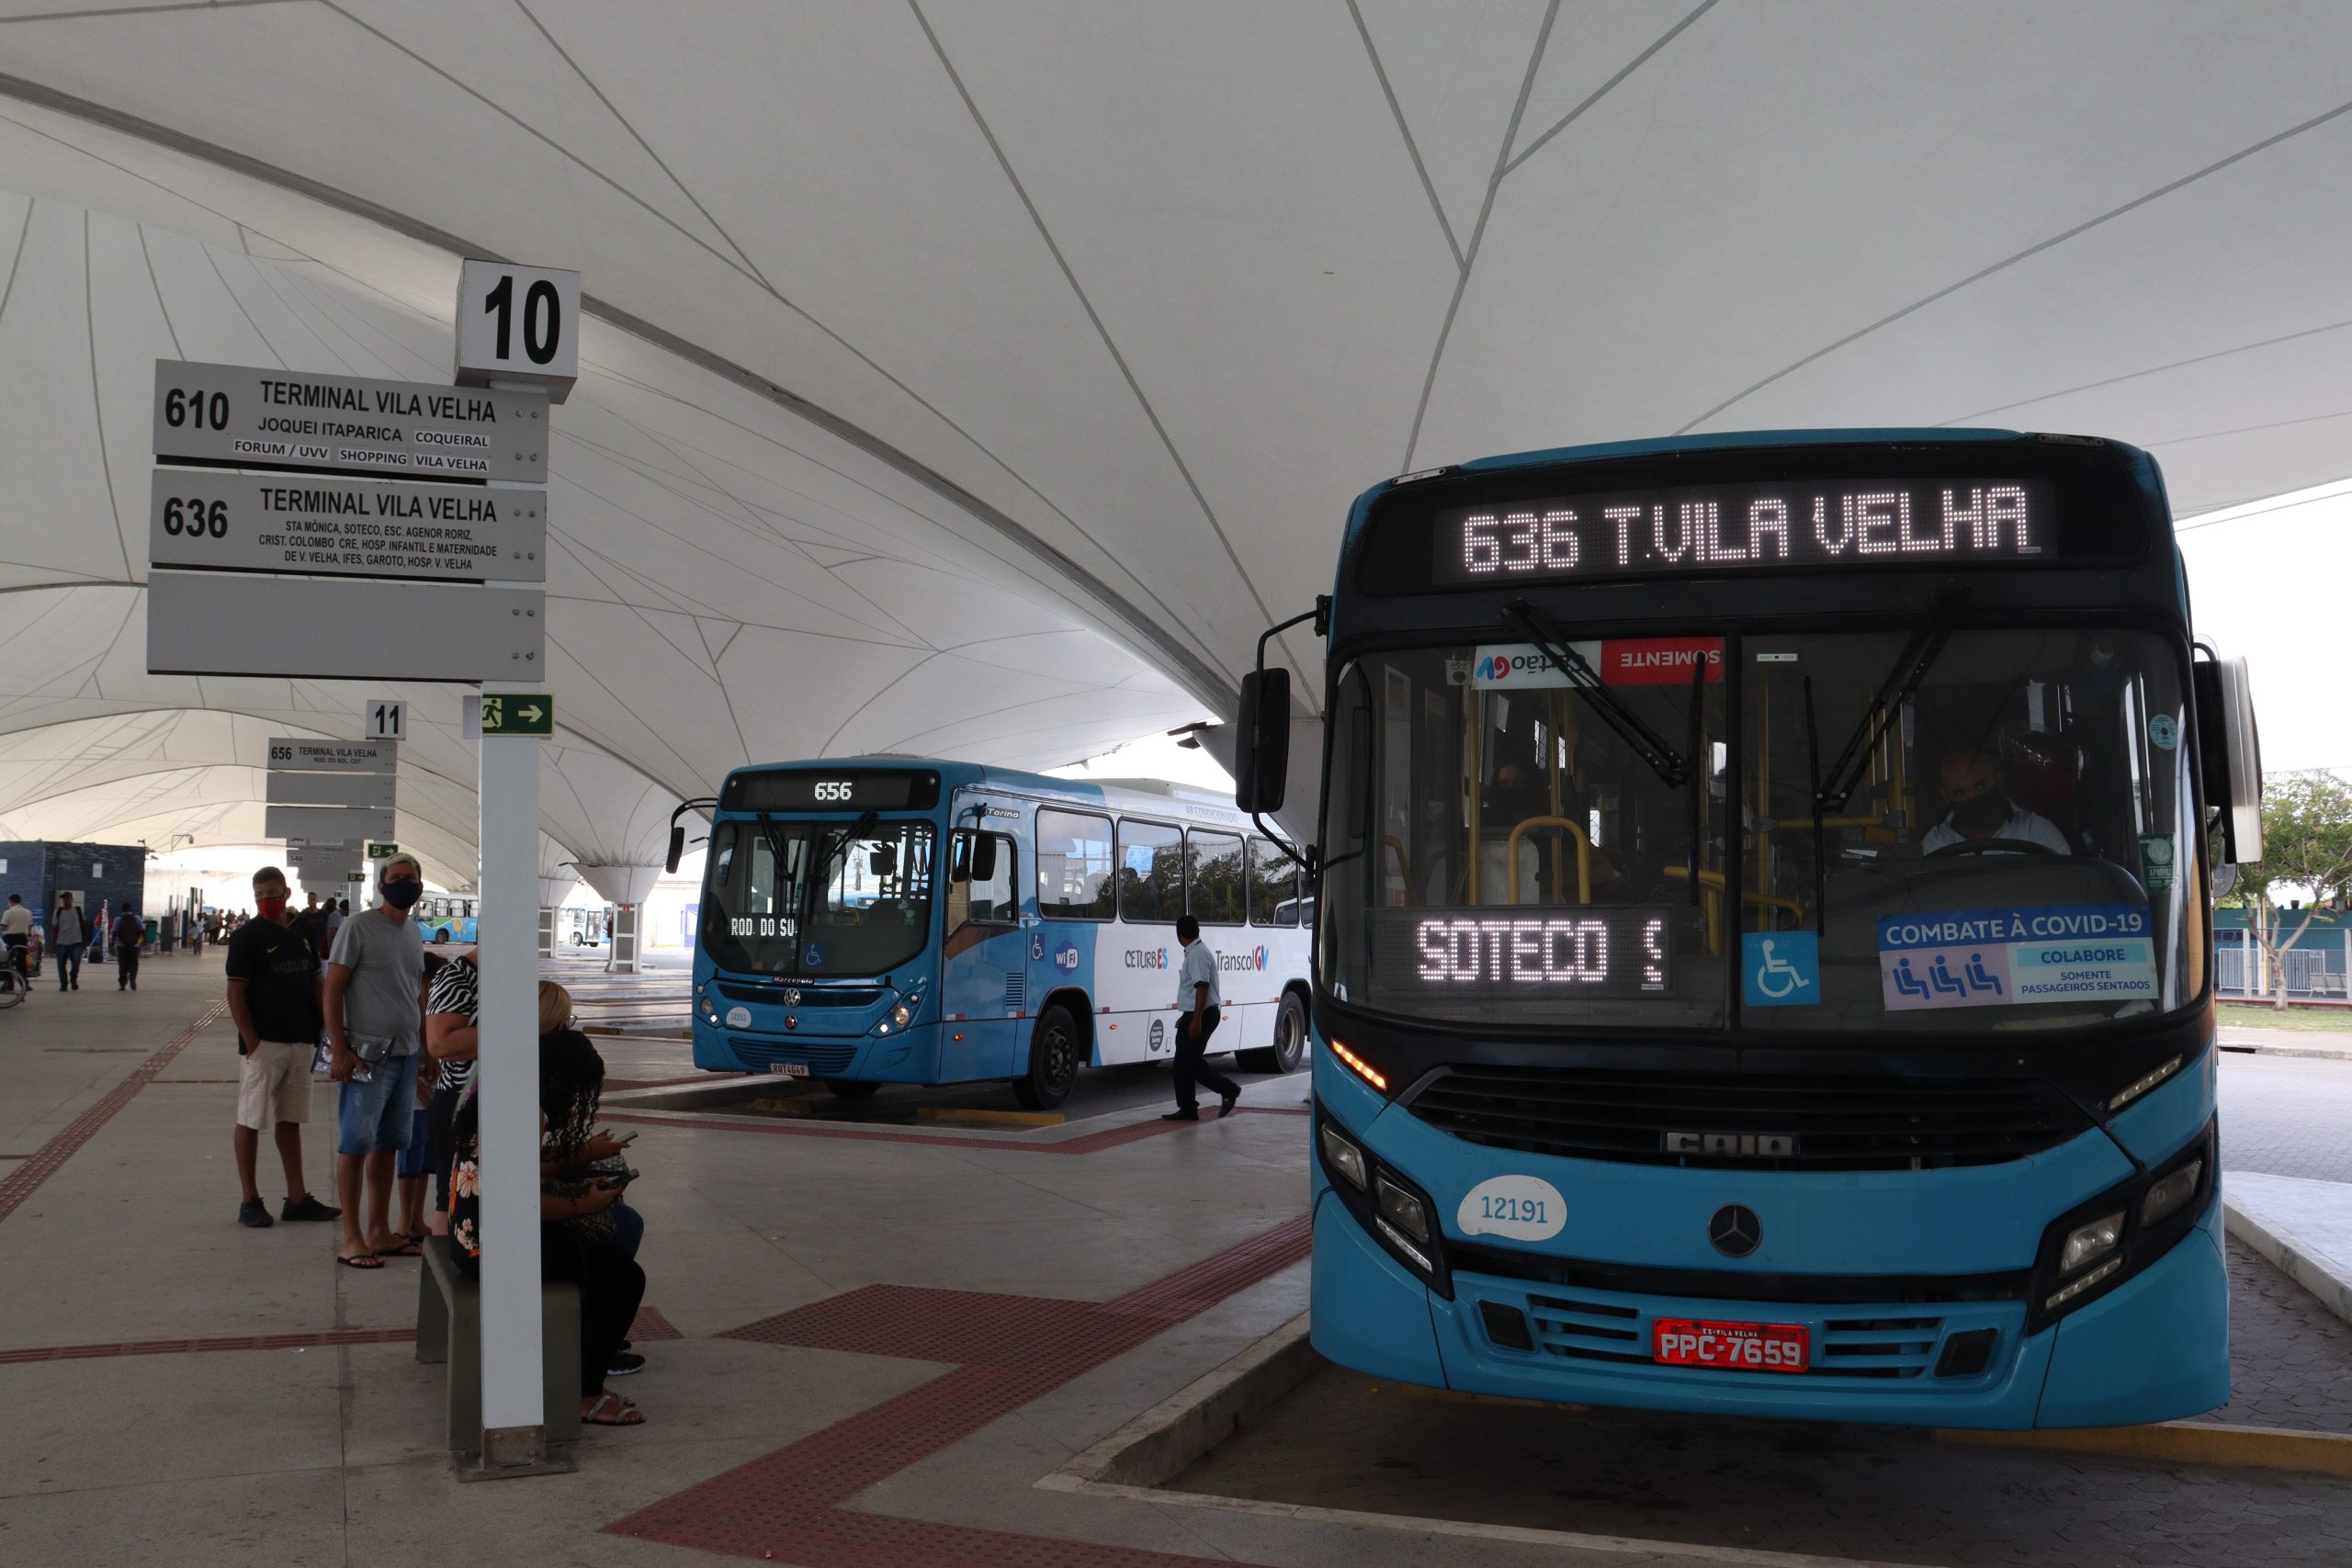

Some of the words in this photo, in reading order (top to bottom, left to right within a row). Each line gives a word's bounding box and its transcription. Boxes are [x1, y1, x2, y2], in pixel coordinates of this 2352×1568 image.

[484, 275, 561, 365] 10
[165, 388, 230, 431] 610
[260, 380, 370, 412] TERMINAL
[376, 390, 423, 416] VILA
[428, 395, 496, 423] VELHA
[258, 417, 317, 435] JOQUEI
[322, 423, 402, 442] ITAPARICA
[415, 432, 489, 448] COQUEIRAL
[234, 440, 285, 456] FORUM
[300, 446, 328, 458] UVV
[340, 449, 407, 465] SHOPPING
[415, 456, 444, 468] VILA
[447, 457, 487, 471] VELHA
[164, 497, 228, 538] 636
[260, 488, 370, 515] TERMINAL
[377, 493, 423, 518] VILA
[428, 497, 497, 522] VELHA
[286, 521, 302, 531] STA
[344, 524, 381, 536] SOTECO,
[385, 525, 403, 536] ESC.
[406, 526, 442, 538] AGENOR
[445, 529, 472, 541] RORIZ,
[1463, 511, 1579, 572] 636
[1813, 485, 2029, 555] VELHA
[259, 535, 287, 547] CRIST.
[289, 536, 334, 548] COLOMBO
[339, 538, 359, 550] CRE,
[362, 539, 386, 550] HOSP.
[389, 540, 426, 552] INFANTIL
[429, 543, 435, 553] E
[436, 543, 497, 556] MATERNIDADE
[285, 551, 297, 561] DE
[300, 552, 307, 562] V.
[309, 552, 340, 564] VELHA,
[343, 553, 364, 566] IFES,
[367, 554, 405, 567] GAROTO,
[408, 556, 433, 568] HOSP.
[435, 558, 442, 568] V.
[445, 558, 472, 570] VELHA
[375, 705, 399, 734] 11
[271, 747, 292, 761] 656
[299, 747, 334, 756] TERMINAL
[336, 749, 352, 757] VILA
[354, 750, 378, 758] VELHA
[814, 782, 853, 801] 656
[988, 807, 1019, 818] Torino
[730, 918, 755, 936] ROD.
[760, 918, 775, 936] DO
[1886, 919, 2005, 945] COMBATE
[2010, 912, 2027, 937] À
[2032, 913, 2143, 937] COVID-19
[1417, 919, 1608, 982] SOTECO
[2041, 949, 2125, 964] COLABORE
[774, 976, 813, 985] Marcopolo
[2021, 981, 2095, 994] PASSAGEIROS
[2097, 980, 2150, 991] SENTADOS
[2060, 970, 2111, 981] SOMENTE
[1481, 1195, 1548, 1224] 12191
[1661, 1334, 1802, 1367] PPC-7659
